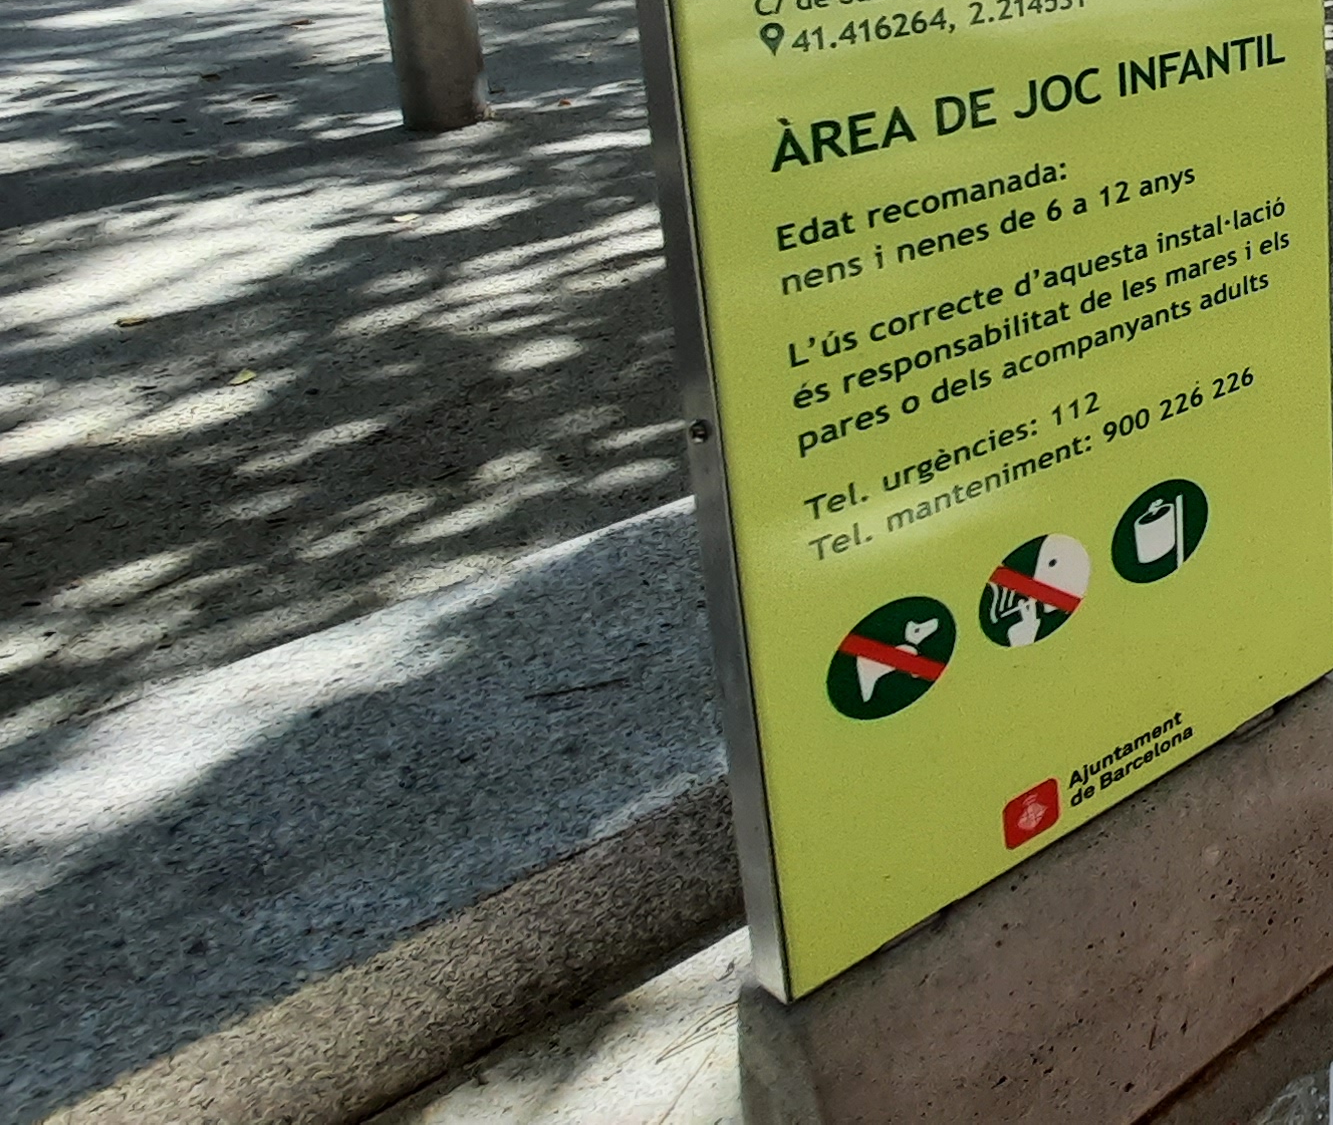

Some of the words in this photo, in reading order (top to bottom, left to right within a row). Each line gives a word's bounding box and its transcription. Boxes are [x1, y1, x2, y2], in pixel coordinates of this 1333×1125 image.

[791, 6, 956, 53] 41.416264,
[770, 105, 918, 173] ÀREA
[934, 86, 998, 137] DE
[1013, 67, 1102, 120] JOC
[1117, 32, 1286, 98] INFANTIL
[775, 211, 856, 252] Edat
[866, 162, 1067, 229] recomanada:
[781, 256, 864, 296] nens
[873, 244, 884, 270] i
[896, 222, 990, 264] nenes
[999, 208, 1036, 235] de
[1046, 197, 1063, 222] 6
[1072, 197, 1088, 216] a
[1099, 180, 1131, 208] 12
[1138, 167, 1196, 198] anys
[788, 330, 859, 369] L'ús
[869, 286, 1004, 342] correcte
[1013, 242, 1149, 298] d'aquesta
[792, 381, 831, 410] és
[842, 301, 1071, 395] responsabilitat
[1079, 289, 1113, 315] de
[1121, 276, 1158, 302] les
[1165, 250, 1238, 287] mares
[1244, 245, 1252, 261] i
[1259, 232, 1290, 256] els
[797, 403, 891, 459] pares
[900, 394, 921, 415] o
[930, 367, 993, 405] dels
[1001, 300, 1193, 380] acompanyants
[1199, 273, 1270, 311] adults
[803, 481, 870, 520] Tel.
[882, 418, 1038, 492] urgències:
[1051, 391, 1101, 427] 112
[808, 522, 873, 561] Tel.
[886, 434, 1092, 533] manteniment:
[1102, 407, 1151, 443] 900
[1158, 386, 1204, 422] 226
[1211, 366, 1254, 400] 226
[1067, 711, 1183, 789] Ajuntament
[1069, 784, 1096, 808] de
[1099, 726, 1194, 791] Barcelona
